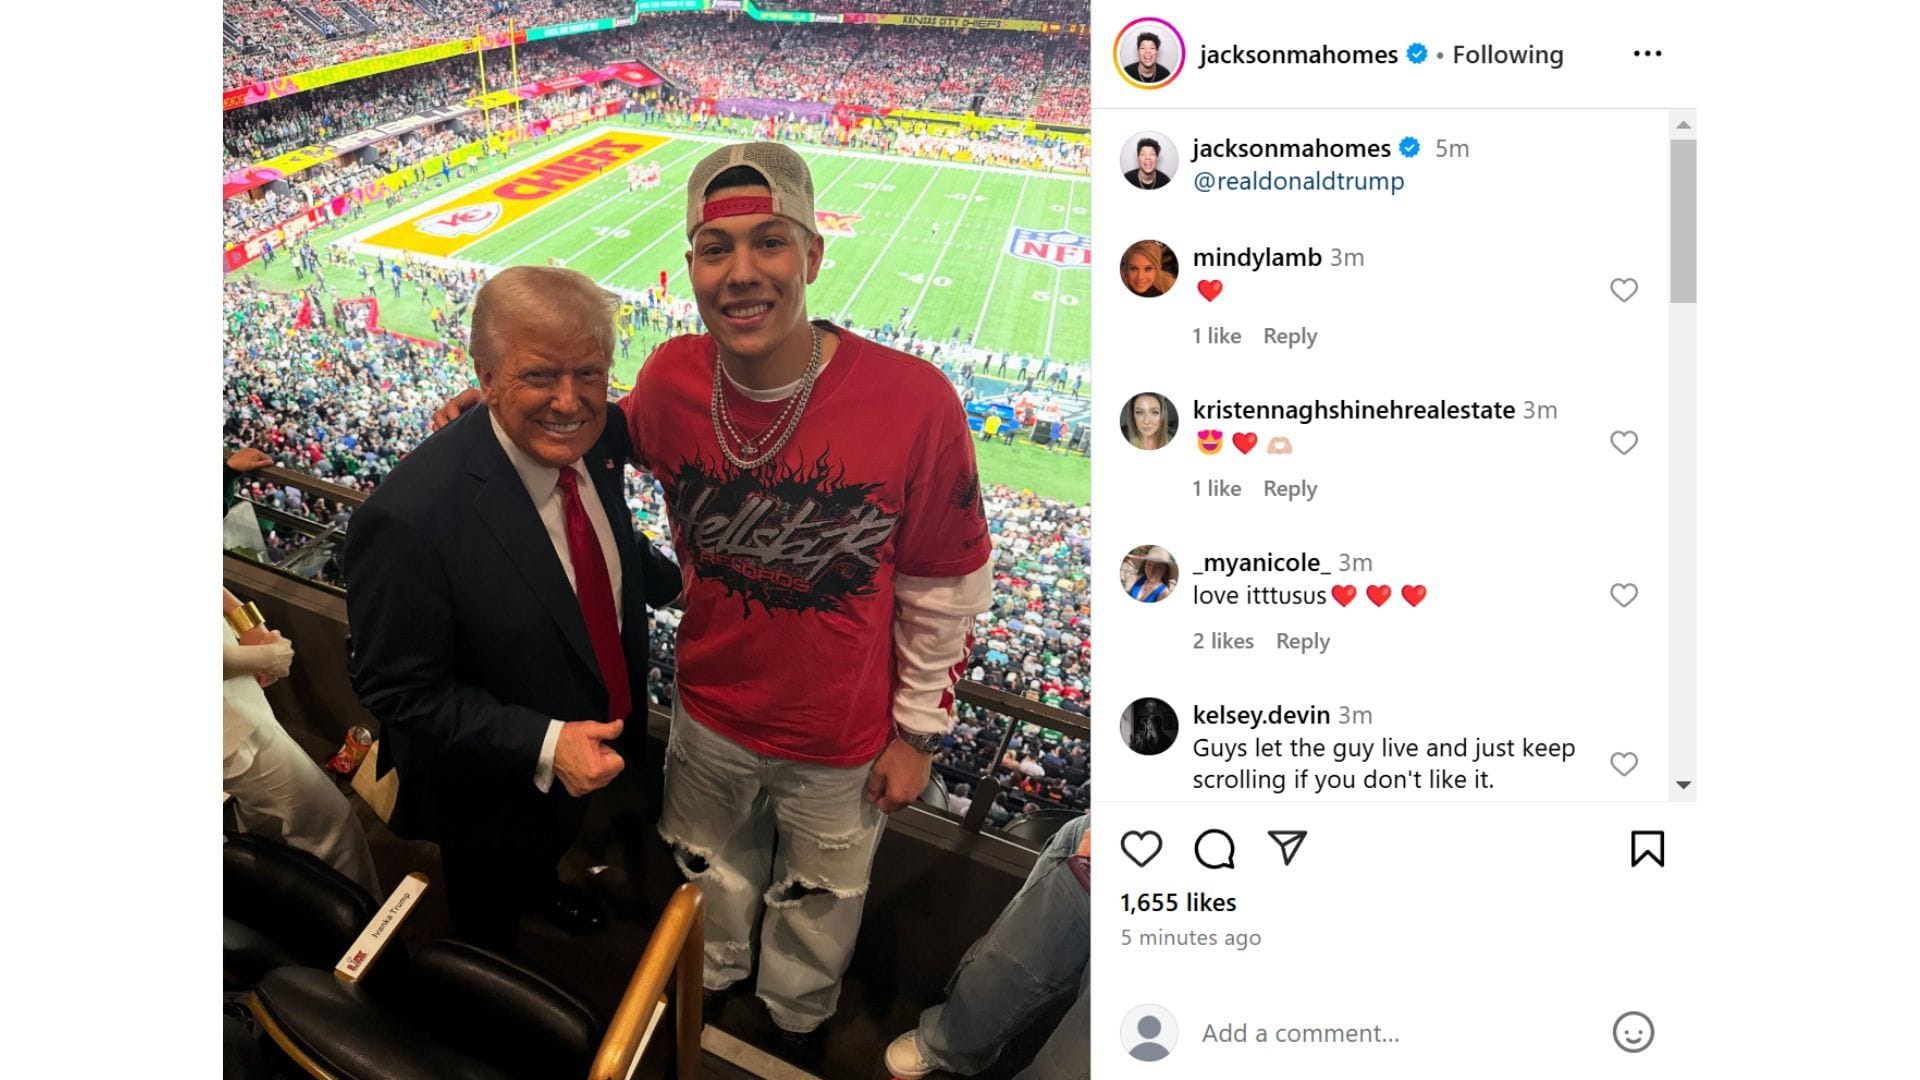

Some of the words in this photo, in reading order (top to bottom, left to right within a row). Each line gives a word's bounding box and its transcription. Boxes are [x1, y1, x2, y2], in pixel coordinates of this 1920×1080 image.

[902, 15, 937, 25] KANSAS
[962, 19, 1001, 28] CHIEFS
[1198, 44, 1398, 69] jacksonmahomes
[1454, 44, 1563, 69] Following
[1190, 138, 1391, 163] jacksonmahomes
[1437, 139, 1468, 157] 5m
[493, 139, 644, 200] CHIEFS
[1195, 171, 1404, 195] @realdonaldtrump
[1194, 247, 1322, 272] mindylamb
[1331, 248, 1363, 266] 3m
[1192, 327, 1201, 344] 1
[1209, 327, 1241, 343] like
[1265, 327, 1317, 349] Reply
[1194, 400, 1515, 424] kristennaghshinehrealestate
[1524, 401, 1557, 419] 3m
[1192, 480, 1201, 497] 1
[1209, 479, 1241, 496] like
[1265, 479, 1318, 502] Reply
[700, 550, 814, 592] RECORDS
[1192, 552, 1331, 577] _myanicole_
[1339, 554, 1372, 571] 3m
[1194, 585, 1239, 604] love
[1248, 585, 1326, 604] itttusus
[1194, 633, 1204, 649] 2
[1212, 632, 1254, 649] likes
[1278, 632, 1330, 654] Reply
[1194, 705, 1330, 729] kelsey.devin
[1339, 706, 1372, 724] 3m
[1193, 739, 1247, 762] Guys
[1256, 737, 1282, 757] let
[1290, 737, 1325, 757] the
[1333, 743, 1374, 762] guy
[1383, 737, 1418, 757] live
[1427, 737, 1467, 757] and
[1472, 737, 1515, 762] just
[1523, 737, 1575, 762] keep
[1194, 769, 1285, 794] scrolling
[1295, 769, 1308, 788] if
[1315, 775, 1355, 794] you
[1364, 769, 1422, 788] don't
[1430, 769, 1466, 788] like
[1475, 769, 1493, 788] it.
[371, 914, 393, 938] Ivanka
[389, 893, 411, 915] Trump
[1121, 893, 1178, 915] 1,655
[1187, 892, 1236, 912] likes
[1122, 929, 1131, 945] 5
[1140, 928, 1217, 945] minutes
[1225, 934, 1261, 950] ago
[1202, 1023, 1246, 1042] Add
[1256, 1029, 1267, 1042] a
[1276, 1026, 1398, 1042] comment...
